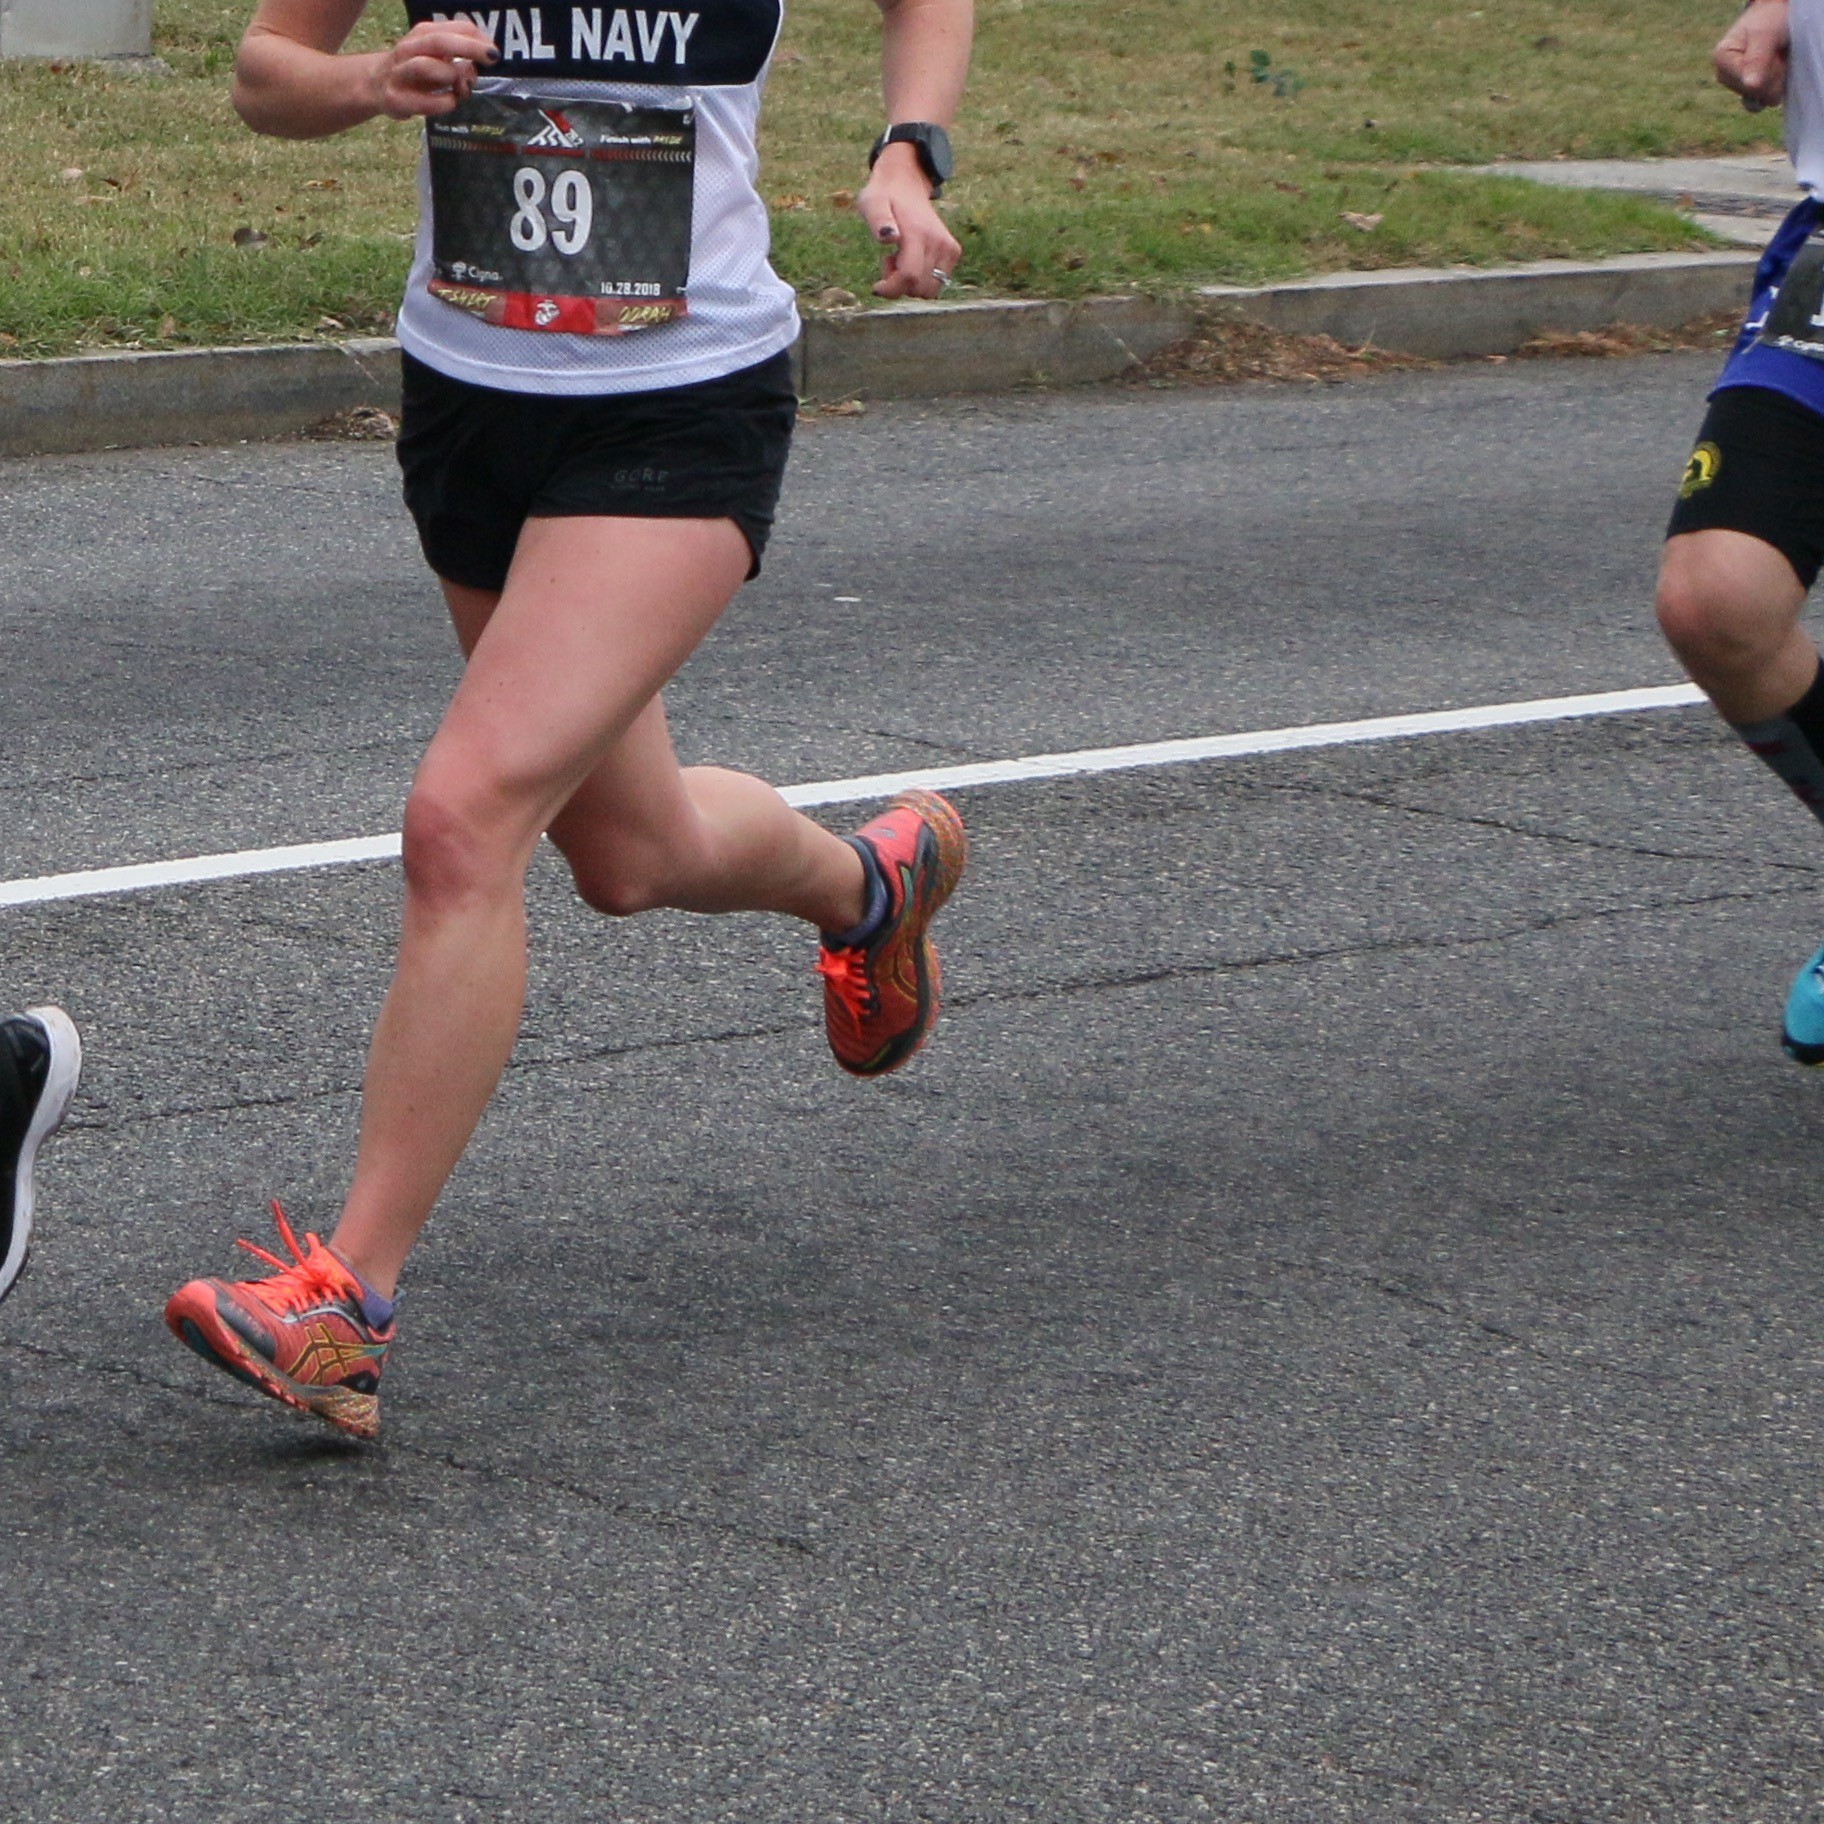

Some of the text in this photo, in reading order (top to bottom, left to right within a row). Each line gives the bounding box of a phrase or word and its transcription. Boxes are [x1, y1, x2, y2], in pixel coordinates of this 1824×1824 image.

[432, 7, 700, 65] YAL NAVY
[510, 166, 593, 255] 89
[600, 281, 662, 296] 10.28.2018
